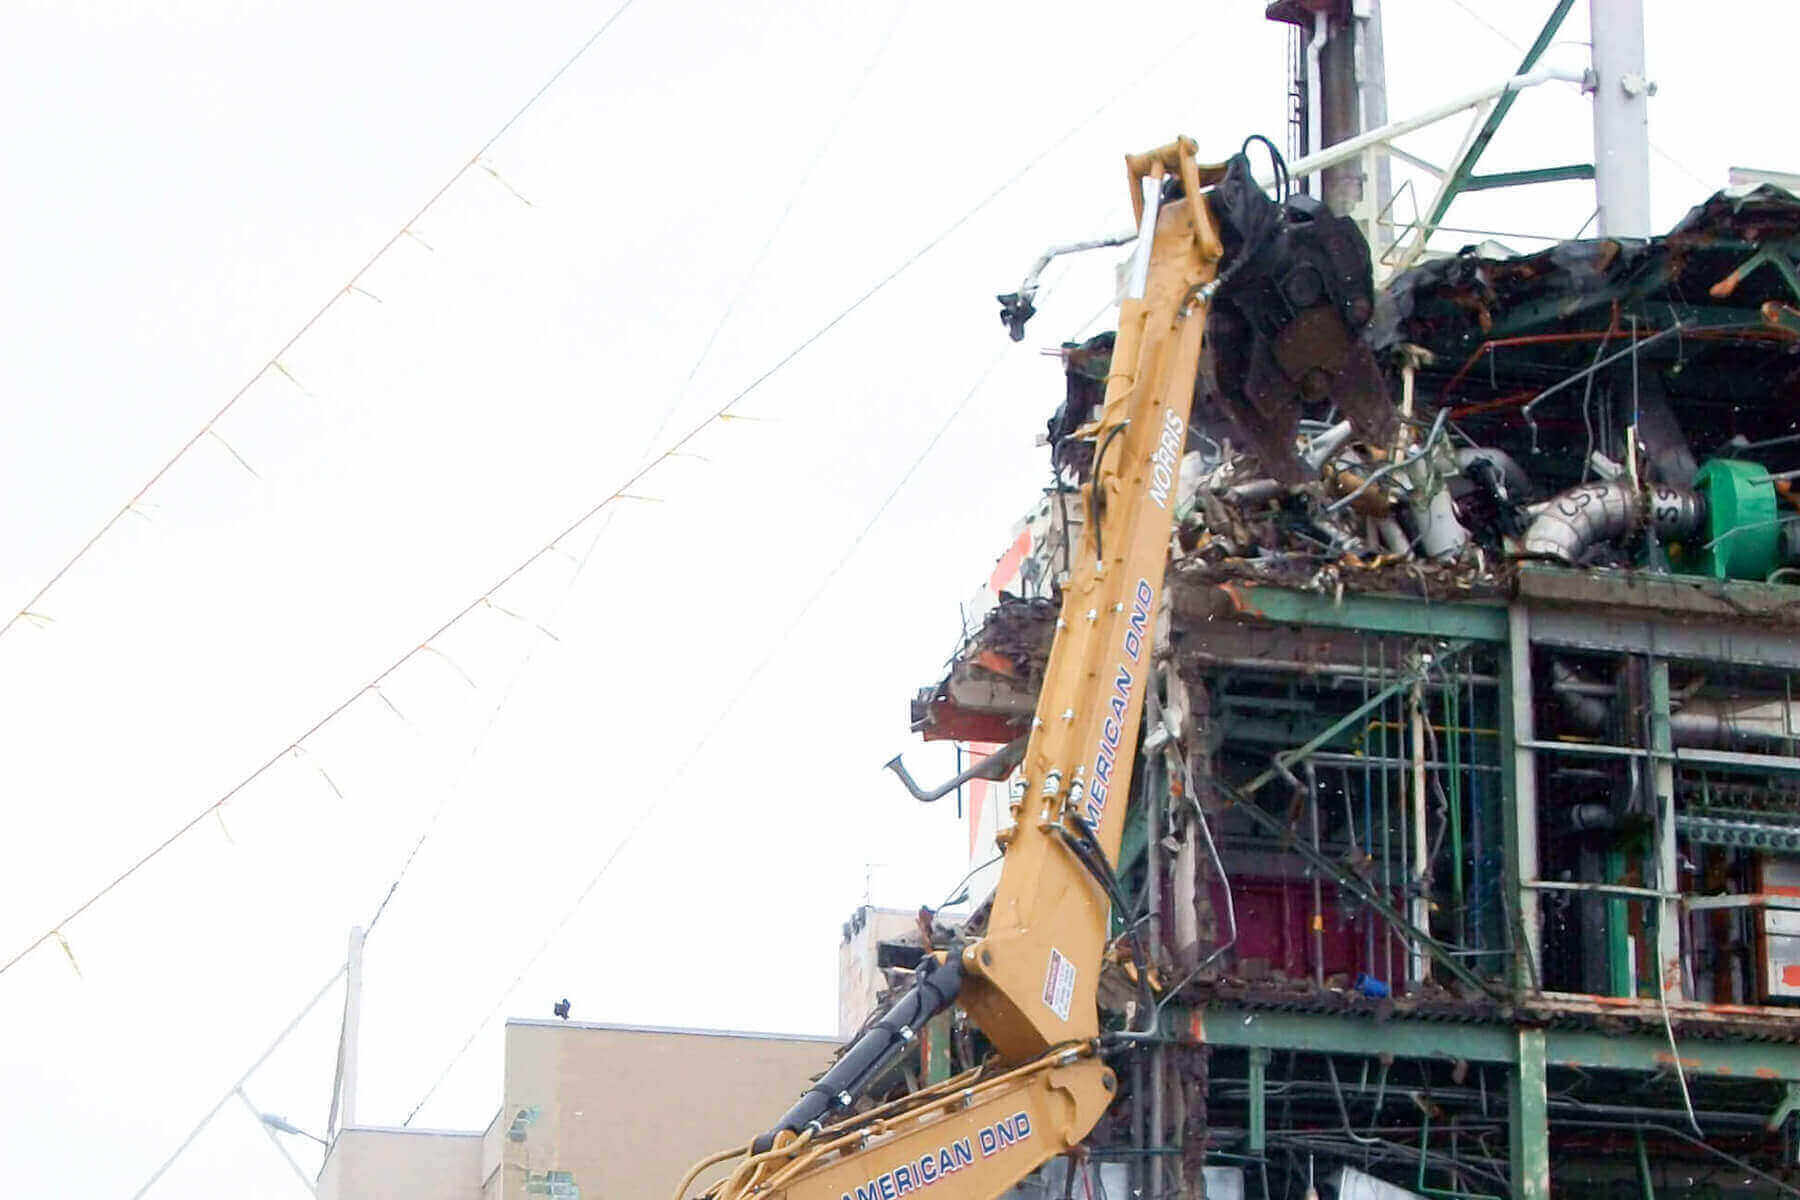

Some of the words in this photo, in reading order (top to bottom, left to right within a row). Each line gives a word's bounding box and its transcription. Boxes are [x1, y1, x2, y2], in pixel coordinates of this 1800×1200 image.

[1150, 408, 1184, 509] NORRIS
[1085, 663, 1134, 834] MERICAN
[1124, 577, 1154, 662] DND
[979, 1110, 1032, 1159] DND
